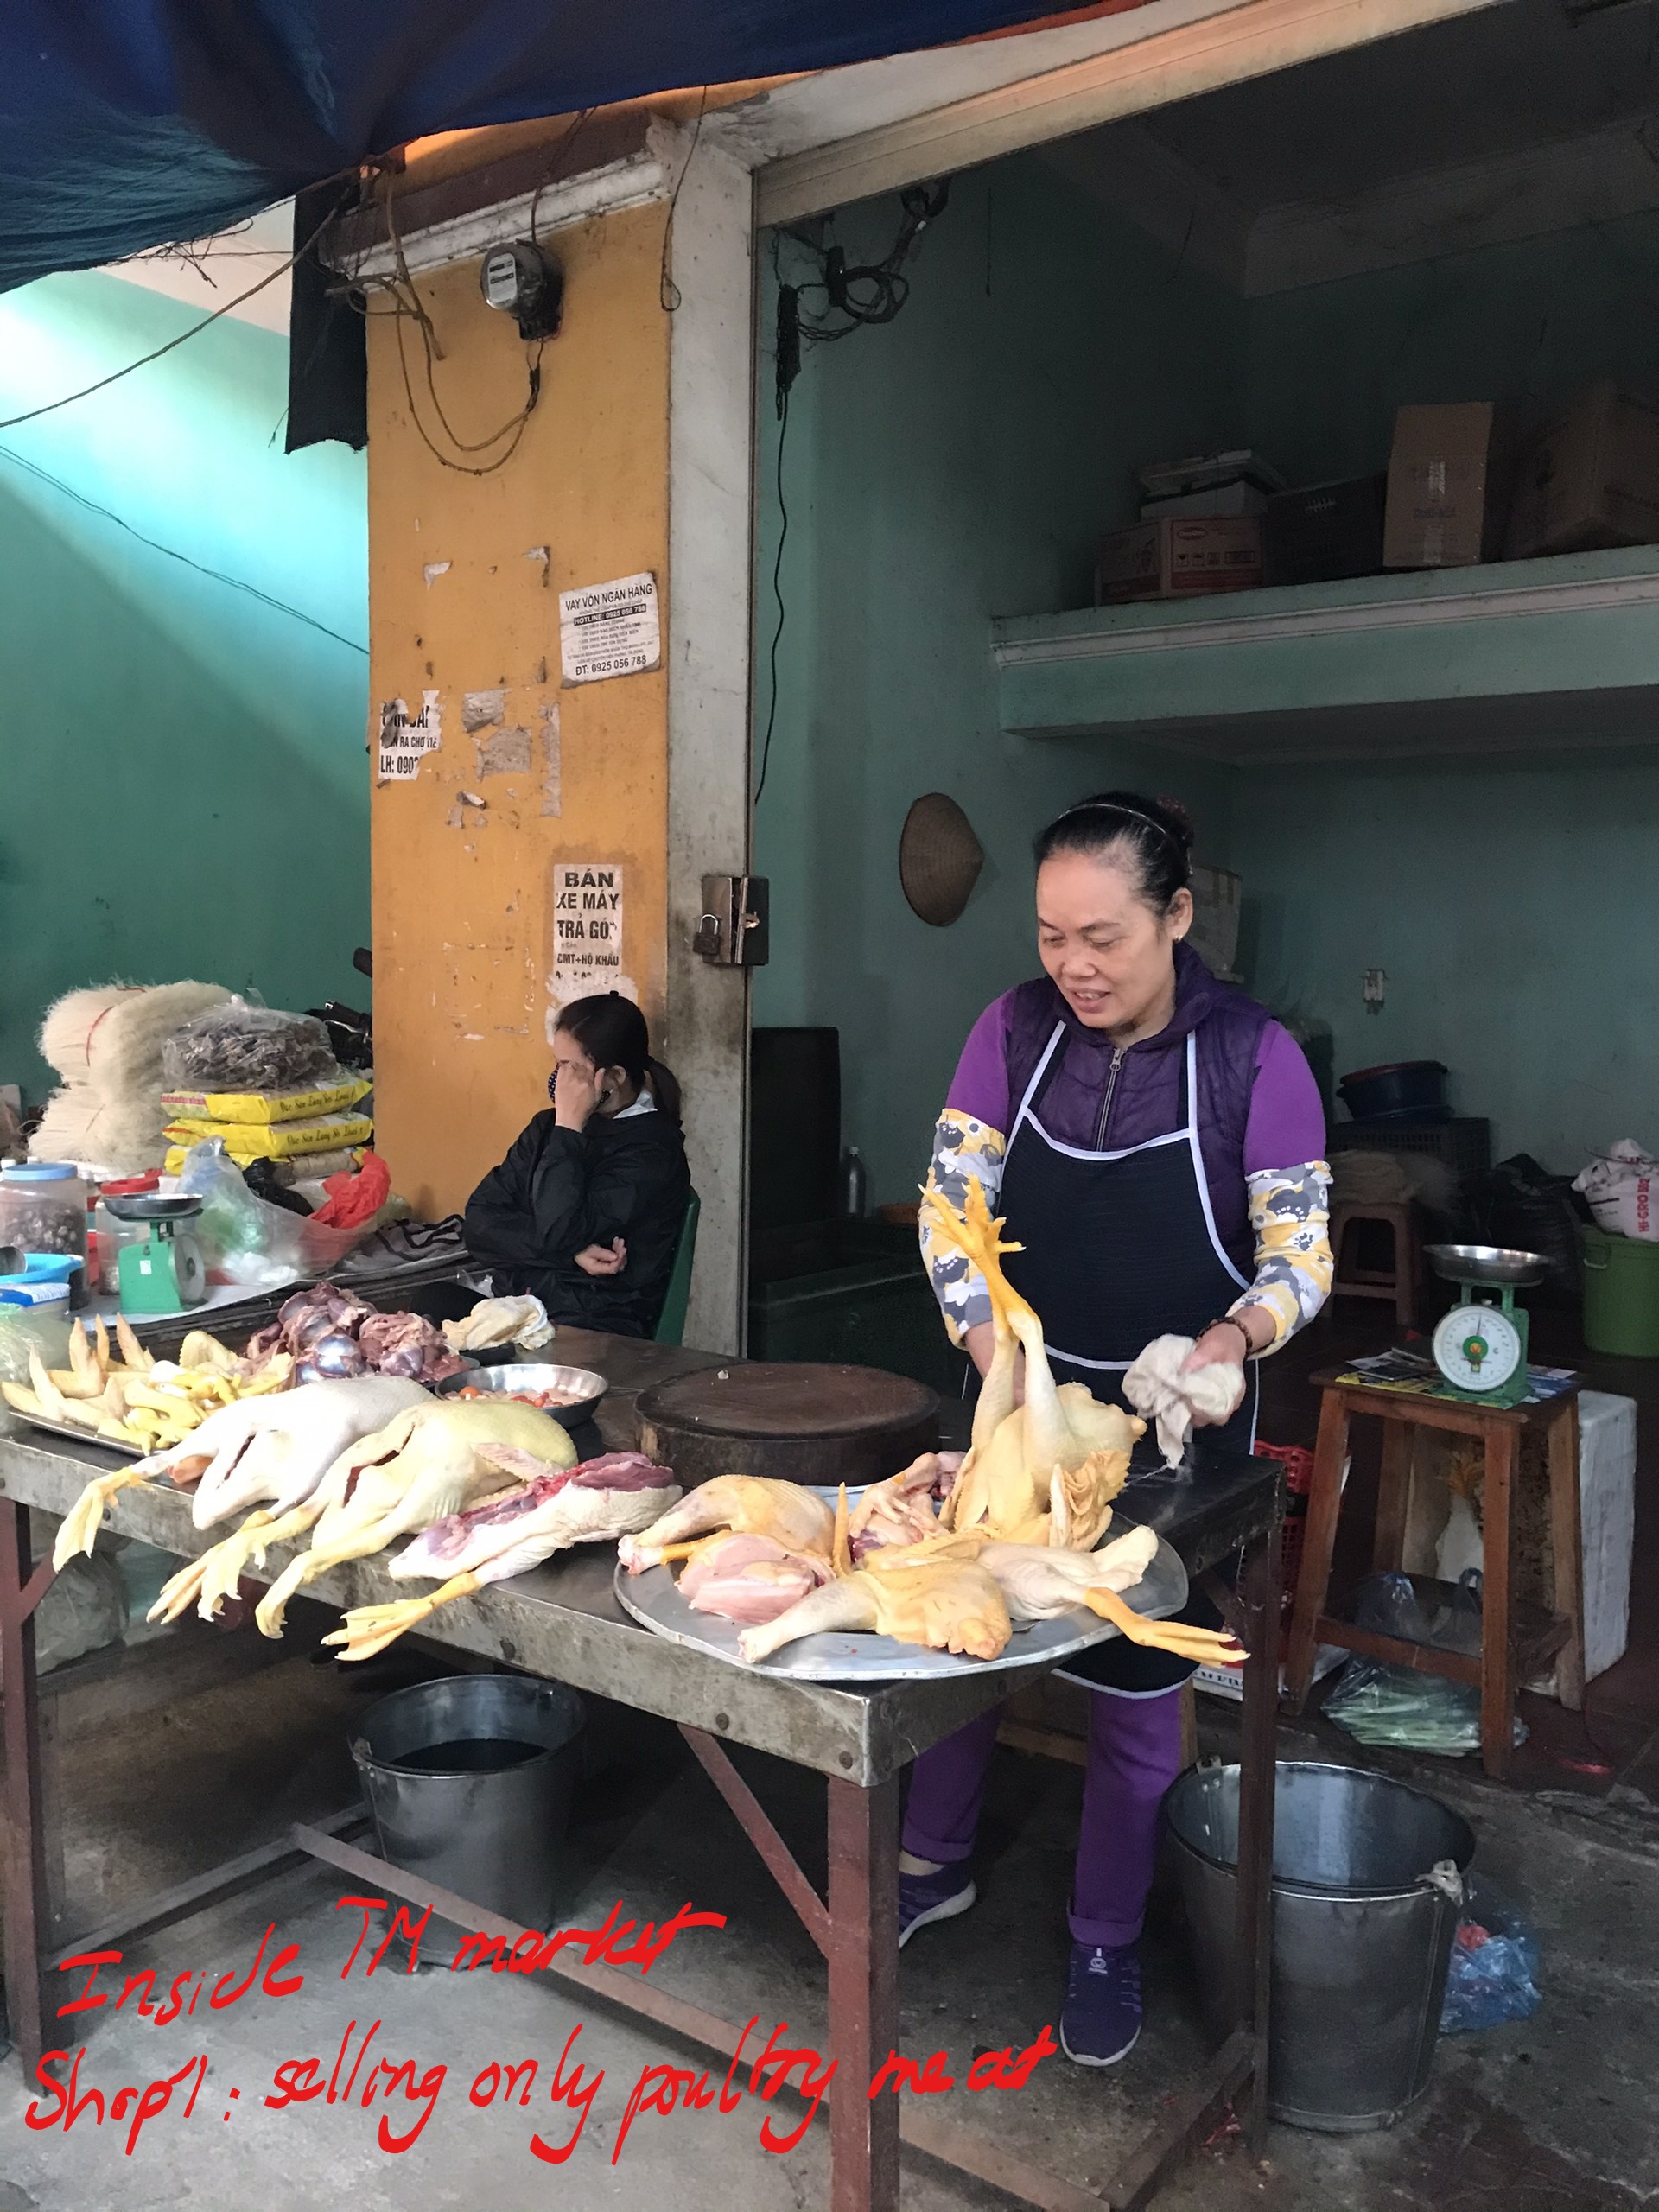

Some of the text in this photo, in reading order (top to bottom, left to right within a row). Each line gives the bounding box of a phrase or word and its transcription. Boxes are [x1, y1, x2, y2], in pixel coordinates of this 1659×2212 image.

[565, 598, 581, 611] VAY
[574, 614, 605, 625] HOTLINE:
[575, 664, 589, 676] ĐT:
[591, 660, 612, 673] 0925
[613, 658, 629, 670] 056
[632, 654, 647, 666] 788
[400, 736, 410, 747] RA
[380, 755, 419, 774] LH: 090
[564, 868, 614, 887] BÁN
[556, 890, 620, 910] XE MÁY
[556, 912, 585, 938] TRẢ
